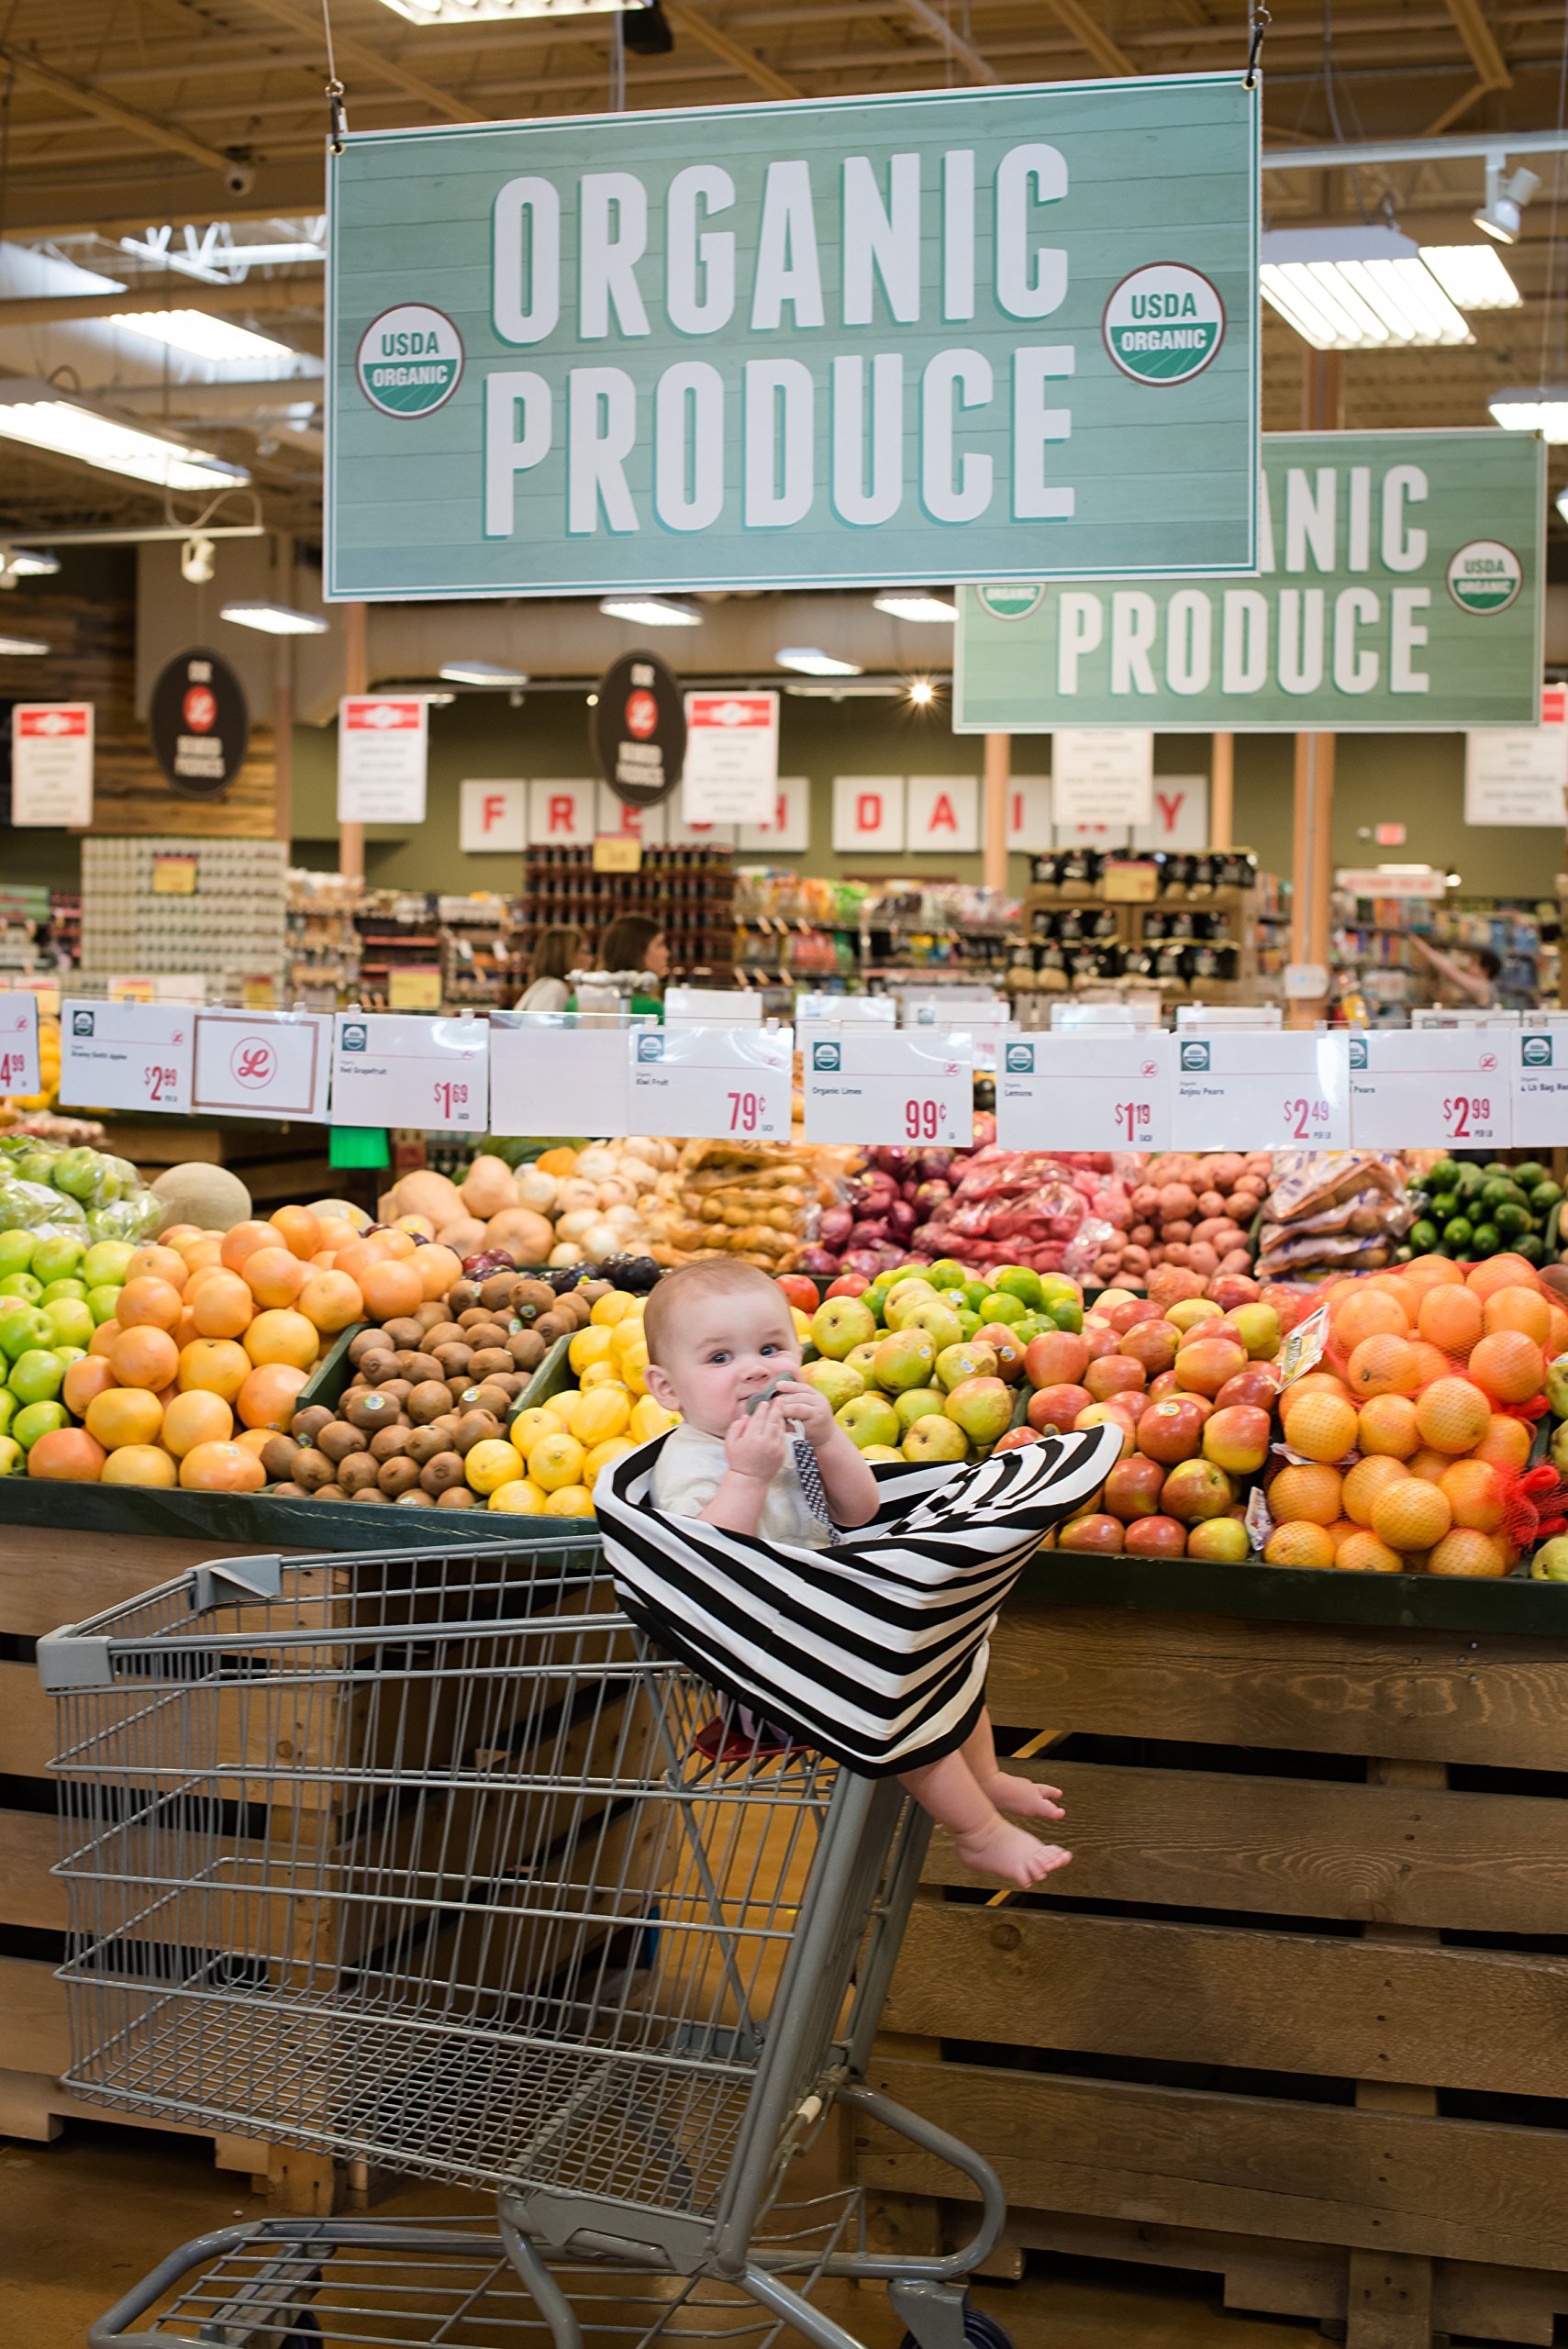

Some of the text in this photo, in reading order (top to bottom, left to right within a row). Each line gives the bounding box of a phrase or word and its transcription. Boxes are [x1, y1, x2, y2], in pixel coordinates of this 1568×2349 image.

[492, 142, 1069, 345] ORGANIC
[1131, 293, 1197, 318] USDA
[382, 331, 439, 357] USDA
[1121, 328, 1207, 351] ORGANIC
[373, 365, 449, 387] ORGANIC
[484, 345, 1075, 540] PRODUCE
[1464, 558, 1505, 573] USDA
[1457, 580, 1512, 596] ORGANIC
[1057, 586, 1431, 696] PRODUCE
[238, 1047, 270, 1077] L
[905, 1099, 948, 1140] 99¢
[1442, 1097, 1491, 1137] $299
